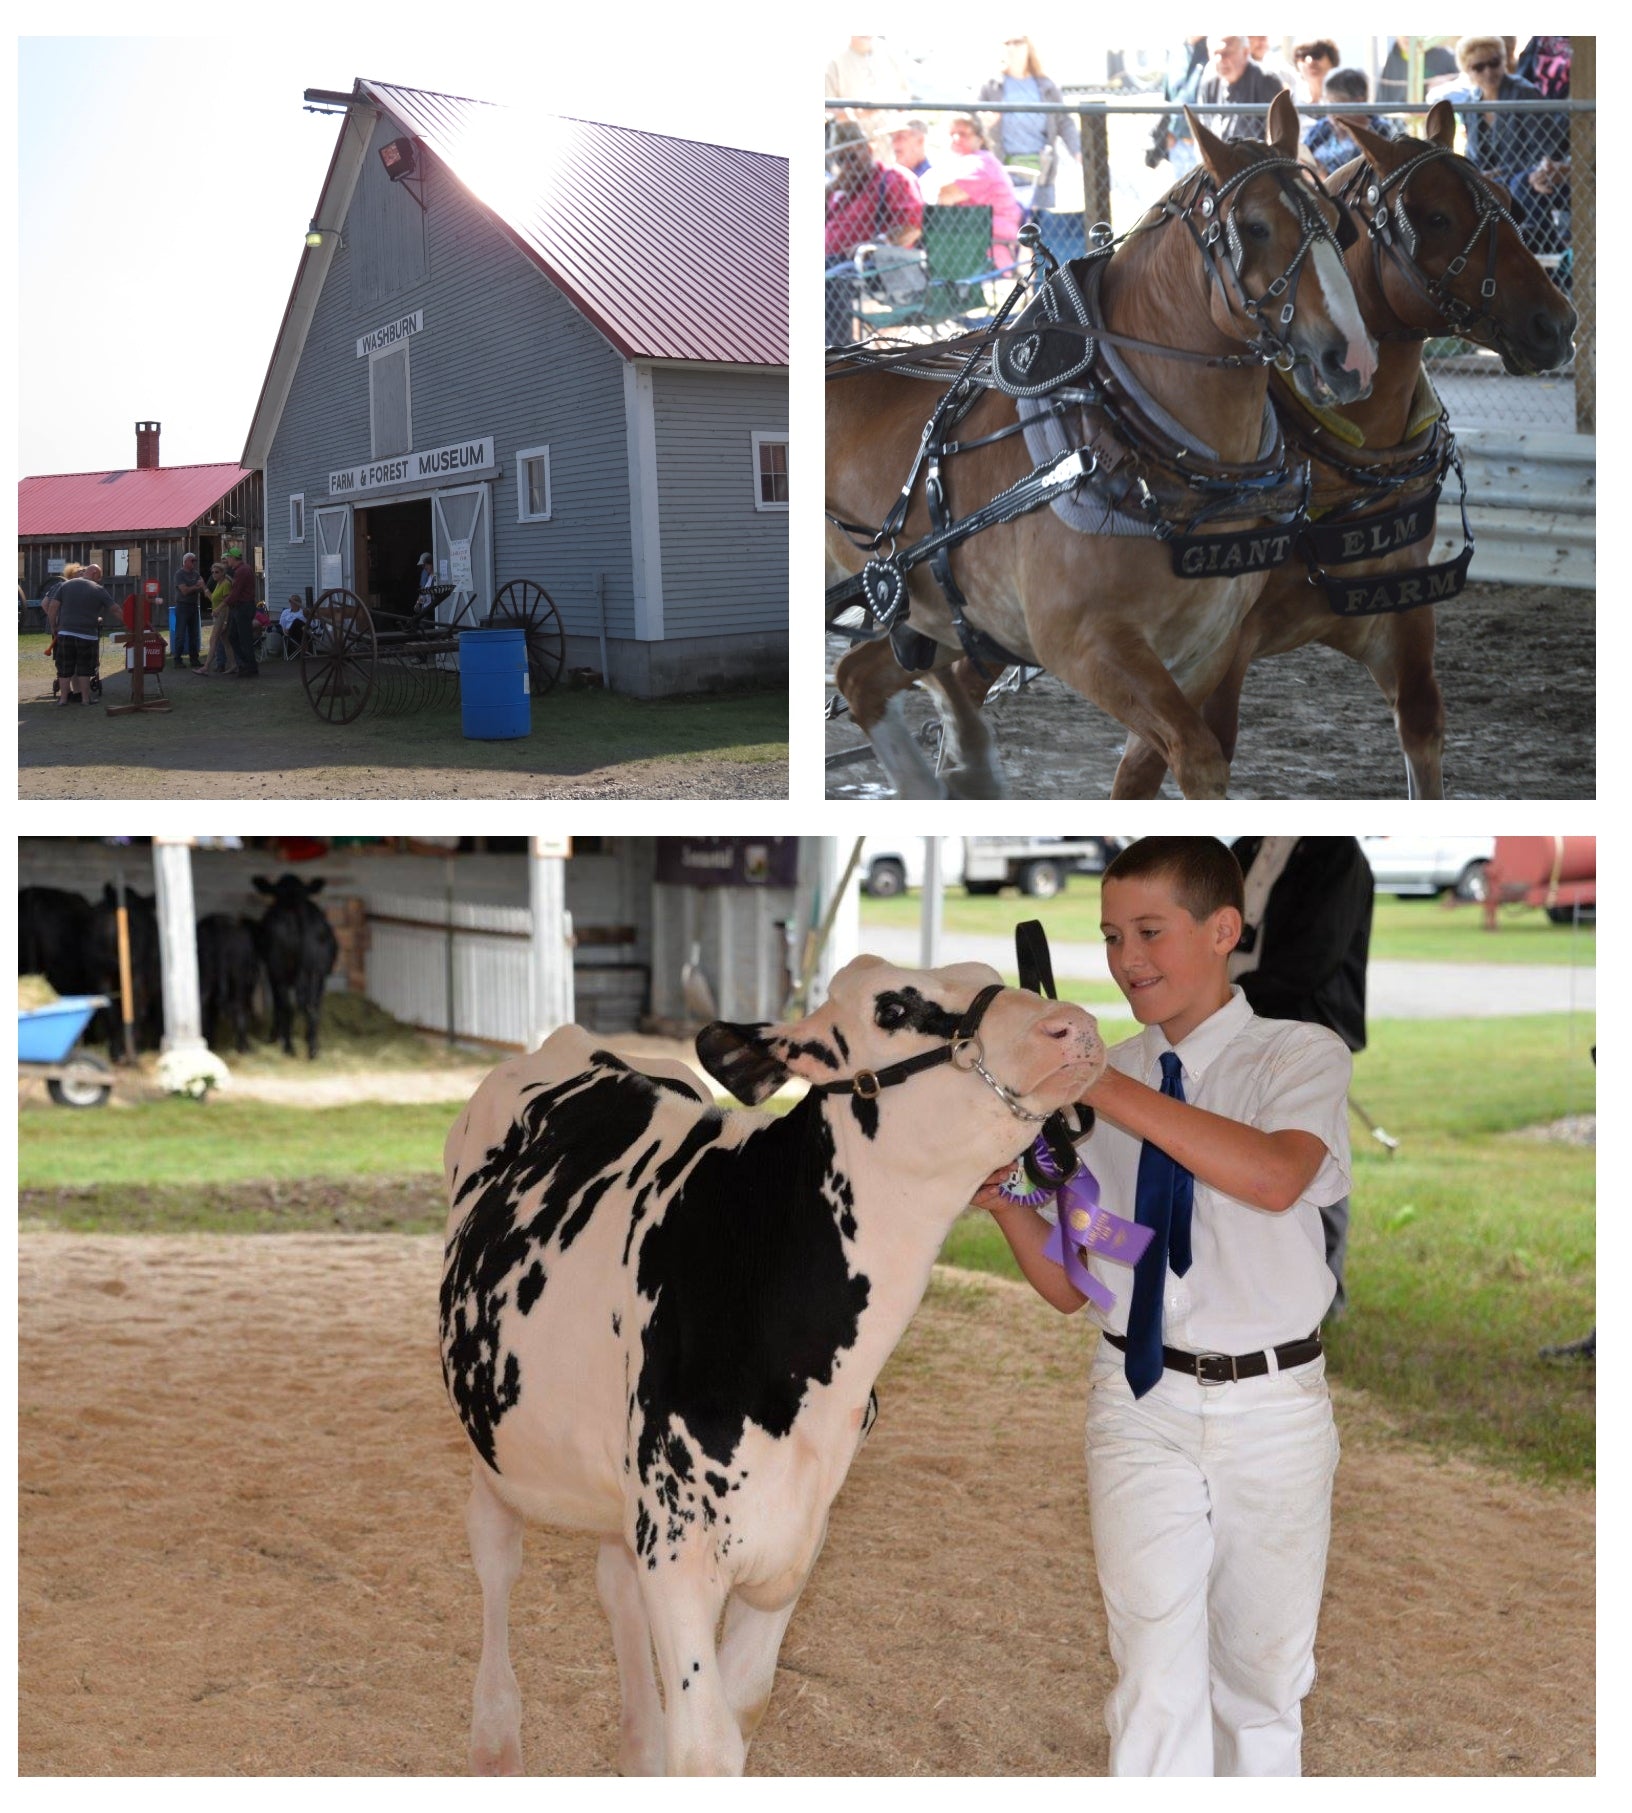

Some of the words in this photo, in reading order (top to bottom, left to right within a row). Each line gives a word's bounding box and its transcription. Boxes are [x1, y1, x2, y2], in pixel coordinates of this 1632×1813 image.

[362, 313, 417, 353] WASHBURN
[331, 472, 354, 491] FARM
[360, 469, 367, 486] &
[369, 460, 409, 485] FOREST
[419, 443, 484, 475] MUSEUM
[1181, 534, 1291, 574] GIANT
[1342, 512, 1418, 557] ELM
[1344, 570, 1459, 612] FARM
